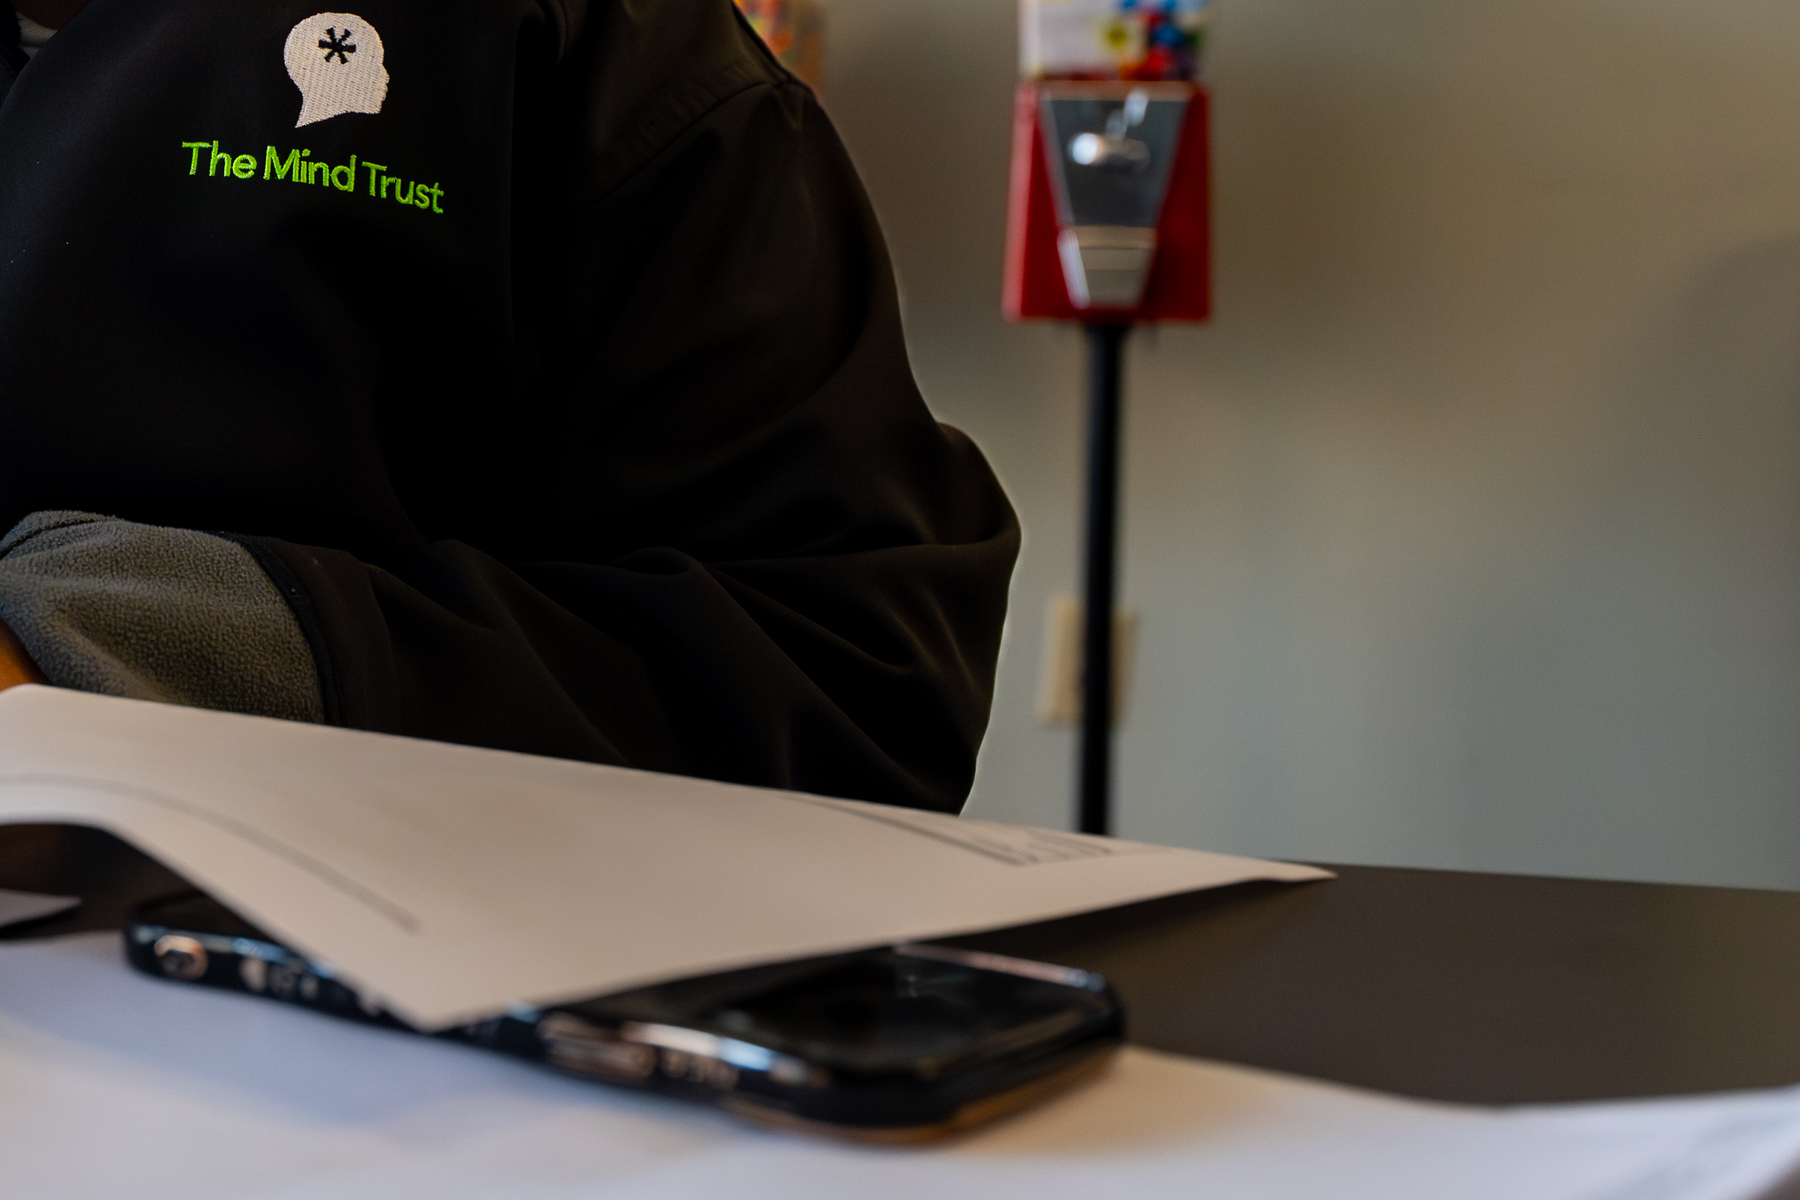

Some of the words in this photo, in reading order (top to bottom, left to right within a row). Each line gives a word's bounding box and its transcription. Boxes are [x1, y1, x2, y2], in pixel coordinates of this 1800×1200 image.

[181, 140, 258, 180] The
[262, 145, 357, 193] Mind
[361, 160, 445, 215] Trust
